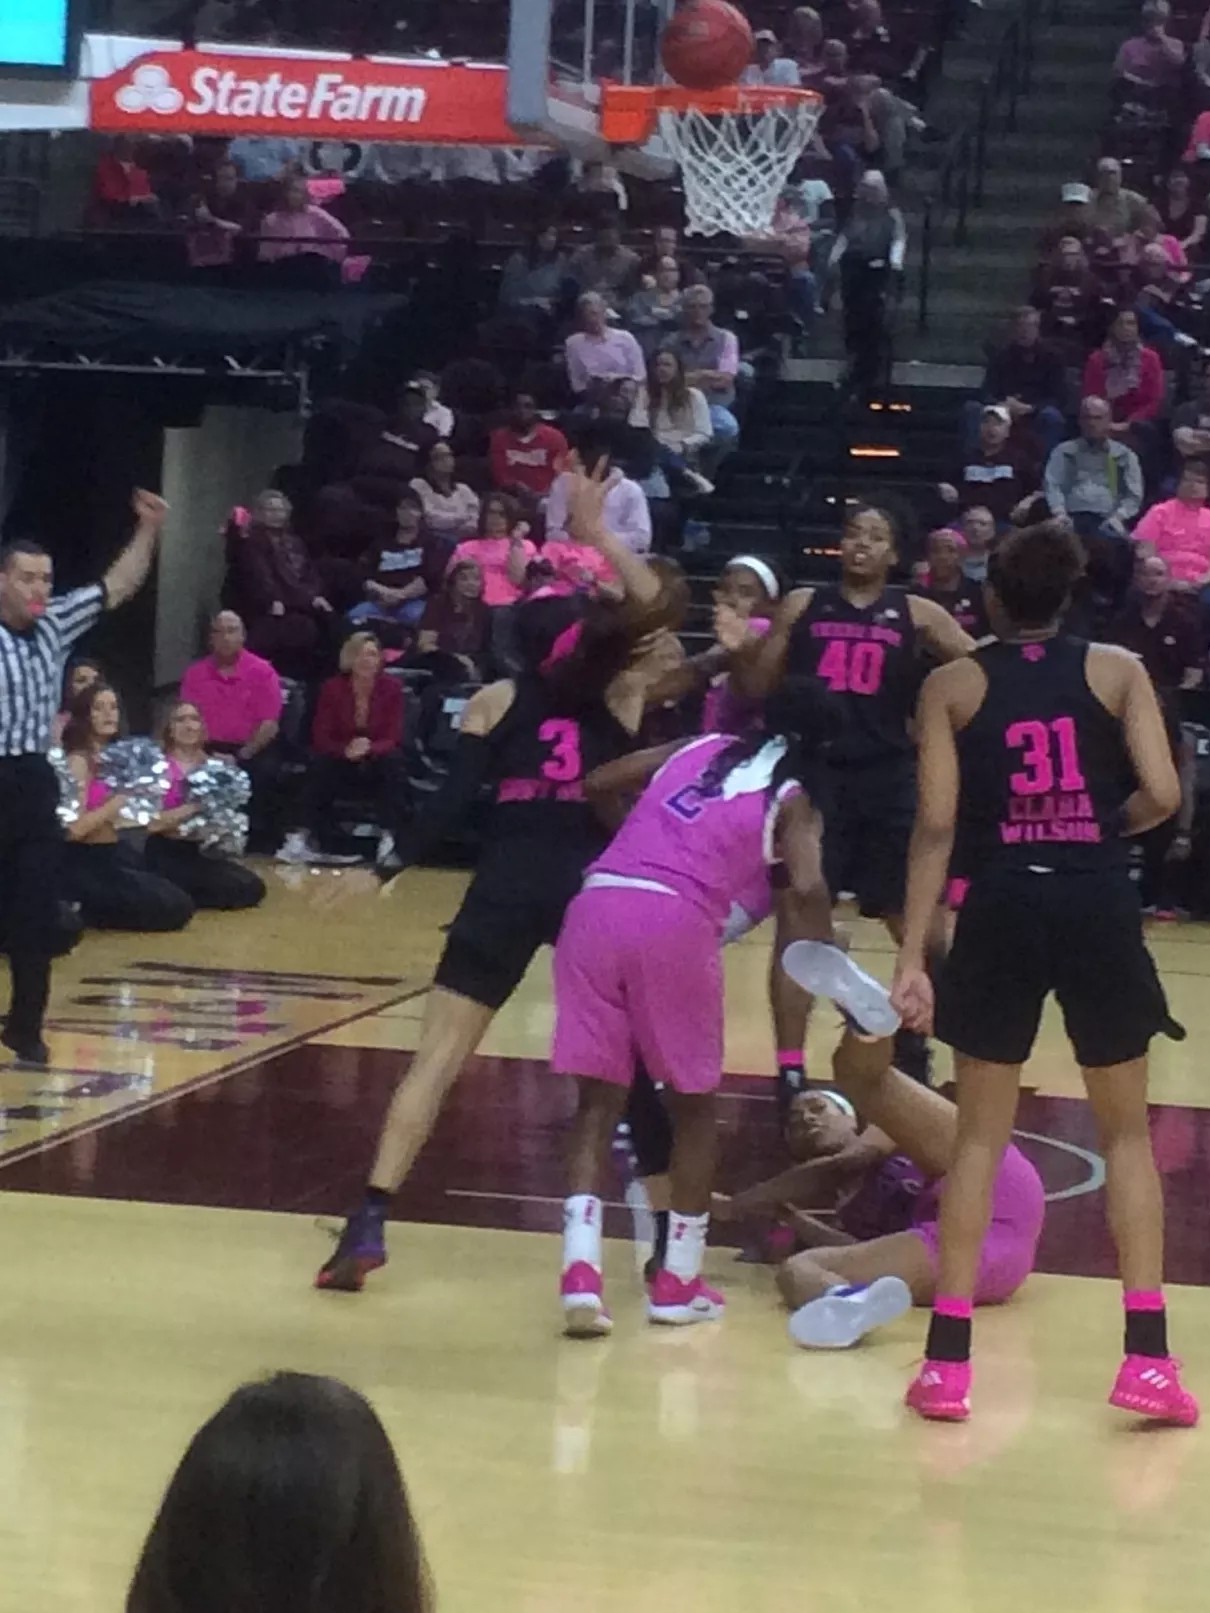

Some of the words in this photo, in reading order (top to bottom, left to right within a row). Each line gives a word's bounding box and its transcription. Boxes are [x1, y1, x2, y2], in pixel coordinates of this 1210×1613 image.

[817, 639, 885, 695] 40
[537, 717, 581, 782] 3
[1004, 716, 1085, 796] 31
